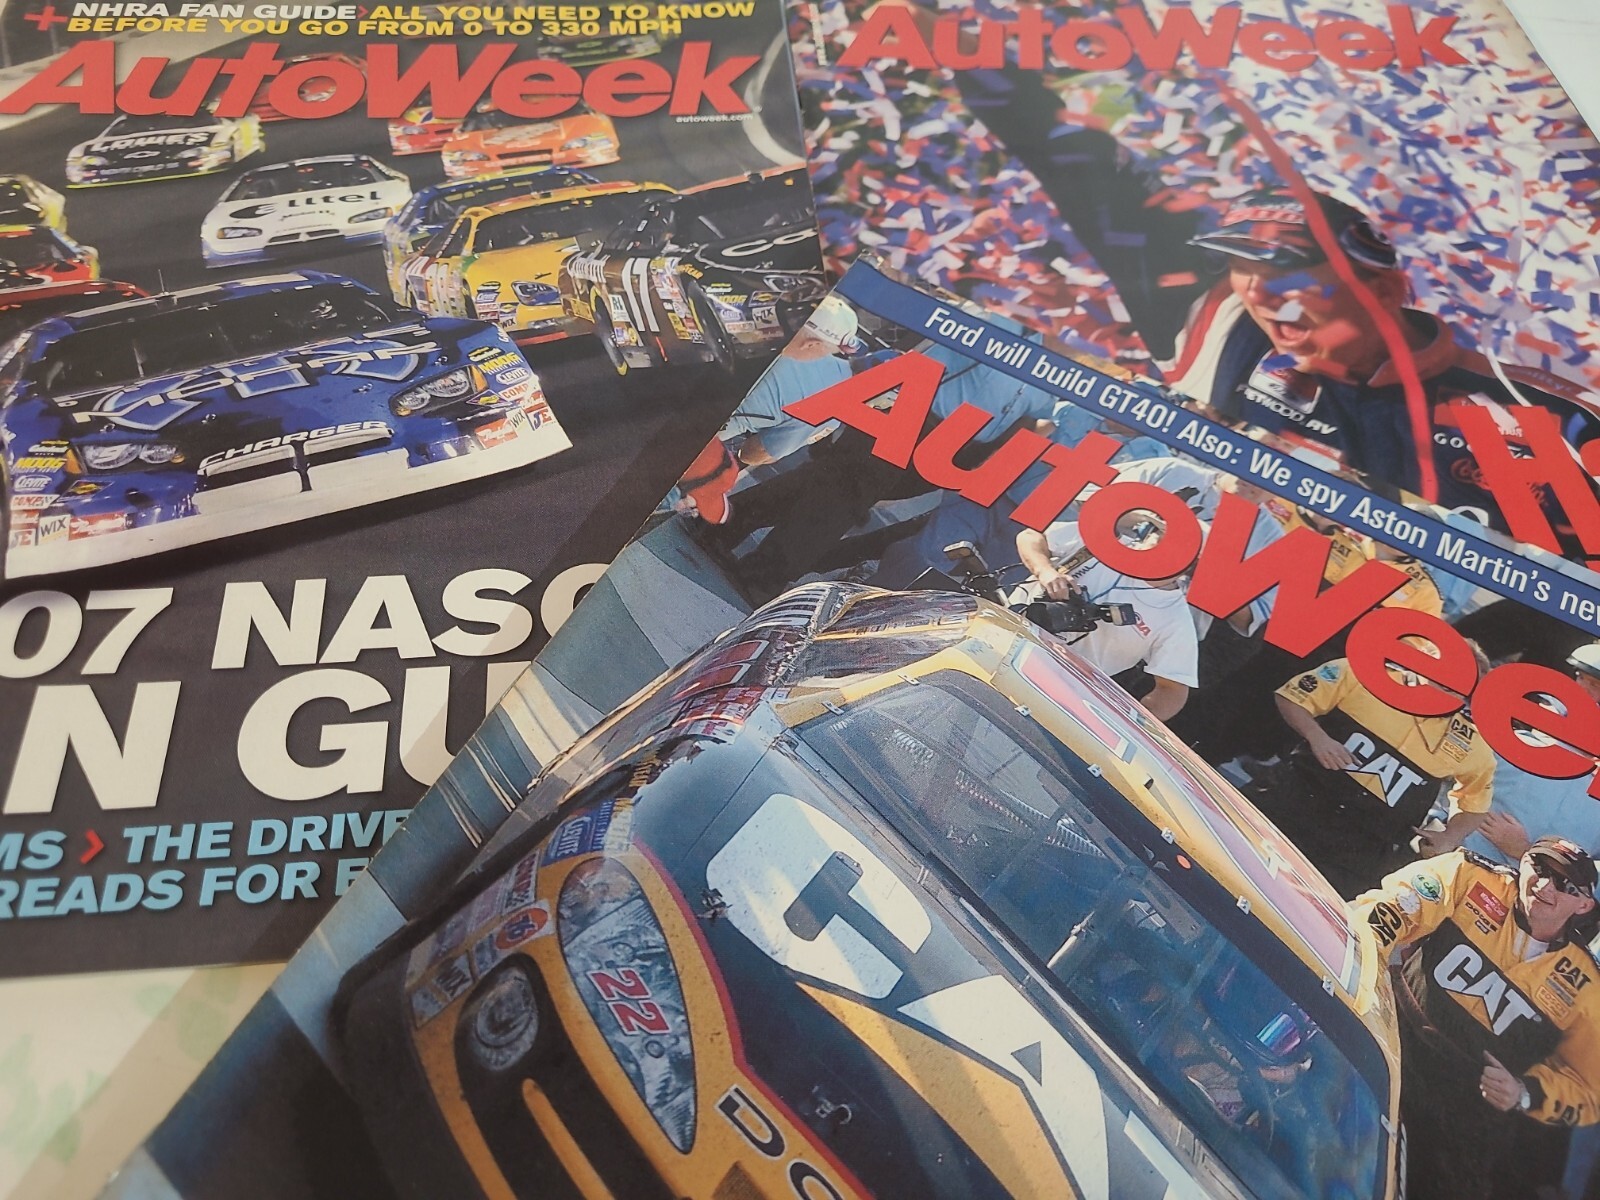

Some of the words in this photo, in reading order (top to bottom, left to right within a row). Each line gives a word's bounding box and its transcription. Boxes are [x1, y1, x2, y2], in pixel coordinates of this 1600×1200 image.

[67, 17, 208, 33] BEFORE
[218, 18, 292, 36] YOU
[299, 19, 350, 36] GO
[358, 19, 448, 37] FROM
[465, 20, 487, 37] 0
[491, 20, 535, 37] TO
[541, 20, 601, 36] 330
[609, 19, 683, 36] MPH
[72, 2, 172, 18] NHRA
[184, 4, 246, 19] FAN
[254, 4, 358, 21] GUIDE
[369, 5, 418, 21] ALL
[440, 5, 504, 22] YOU
[523, 5, 601, 21] NEED
[609, 4, 655, 20] TO
[658, 2, 755, 19] KNOW
[836, 3, 1475, 72] AutoWeek
[0, 40, 762, 119] AutoWeek
[676, 114, 754, 123] autoweek.com
[199, 421, 389, 471] CHARGER
[1305, 419, 1338, 435] RV
[924, 306, 986, 348] Ford
[984, 336, 1034, 371] will
[1031, 347, 1098, 399] build
[1098, 383, 1178, 435] GT40!
[1176, 419, 1245, 465] Also:
[1250, 449, 1292, 487] We
[1297, 477, 1347, 513] spy
[1349, 497, 1429, 549] Aston
[1434, 532, 1551, 602] Martin's
[1559, 591, 1600, 627] ne
[1449, 405, 1600, 556] H
[40, 517, 67, 537] WIX
[1331, 540, 1352, 558] CAT
[780, 350, 1600, 801] AutoWee
[1404, 566, 1426, 583] CAT
[0, 587, 174, 679] 07
[1451, 718, 1476, 741] CAT
[1343, 731, 1424, 808] CAT
[123, 821, 234, 864] THE
[199, 862, 323, 907] FOR
[1367, 901, 1403, 948] CAT
[1434, 943, 1537, 1036] CAT
[1554, 956, 1591, 991] CAT
[591, 969, 670, 1036] 22
